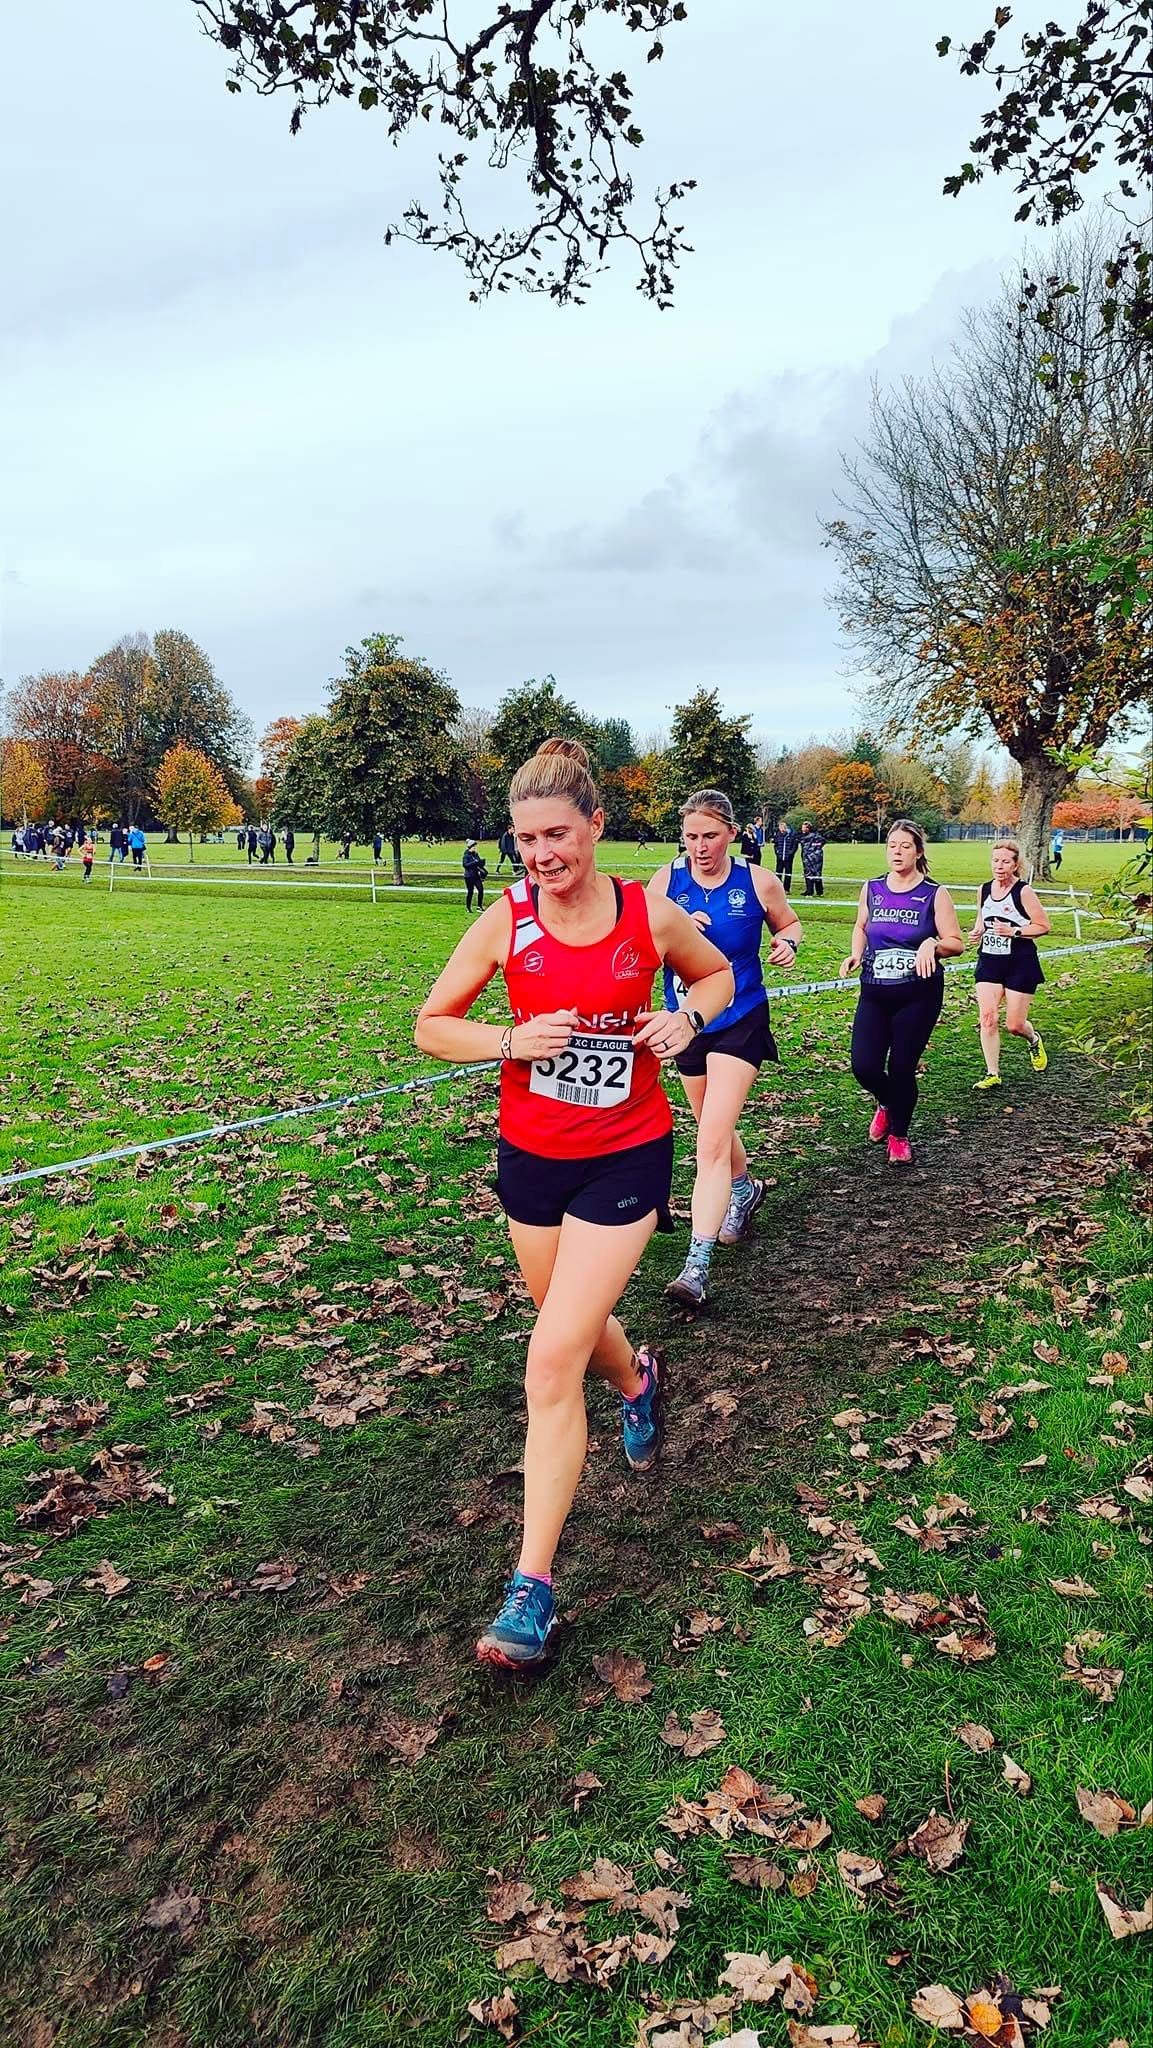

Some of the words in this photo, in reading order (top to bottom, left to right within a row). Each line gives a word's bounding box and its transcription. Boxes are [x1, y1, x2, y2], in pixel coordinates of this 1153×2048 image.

[873, 908, 920, 919] CALDICOT
[901, 917, 919, 925] CLUB
[984, 935, 1009, 949] 3964
[875, 957, 917, 970] 3458
[575, 1039, 588, 1048] XC
[590, 1040, 629, 1050] LEAGUE
[617, 1196, 639, 1209] dhb
